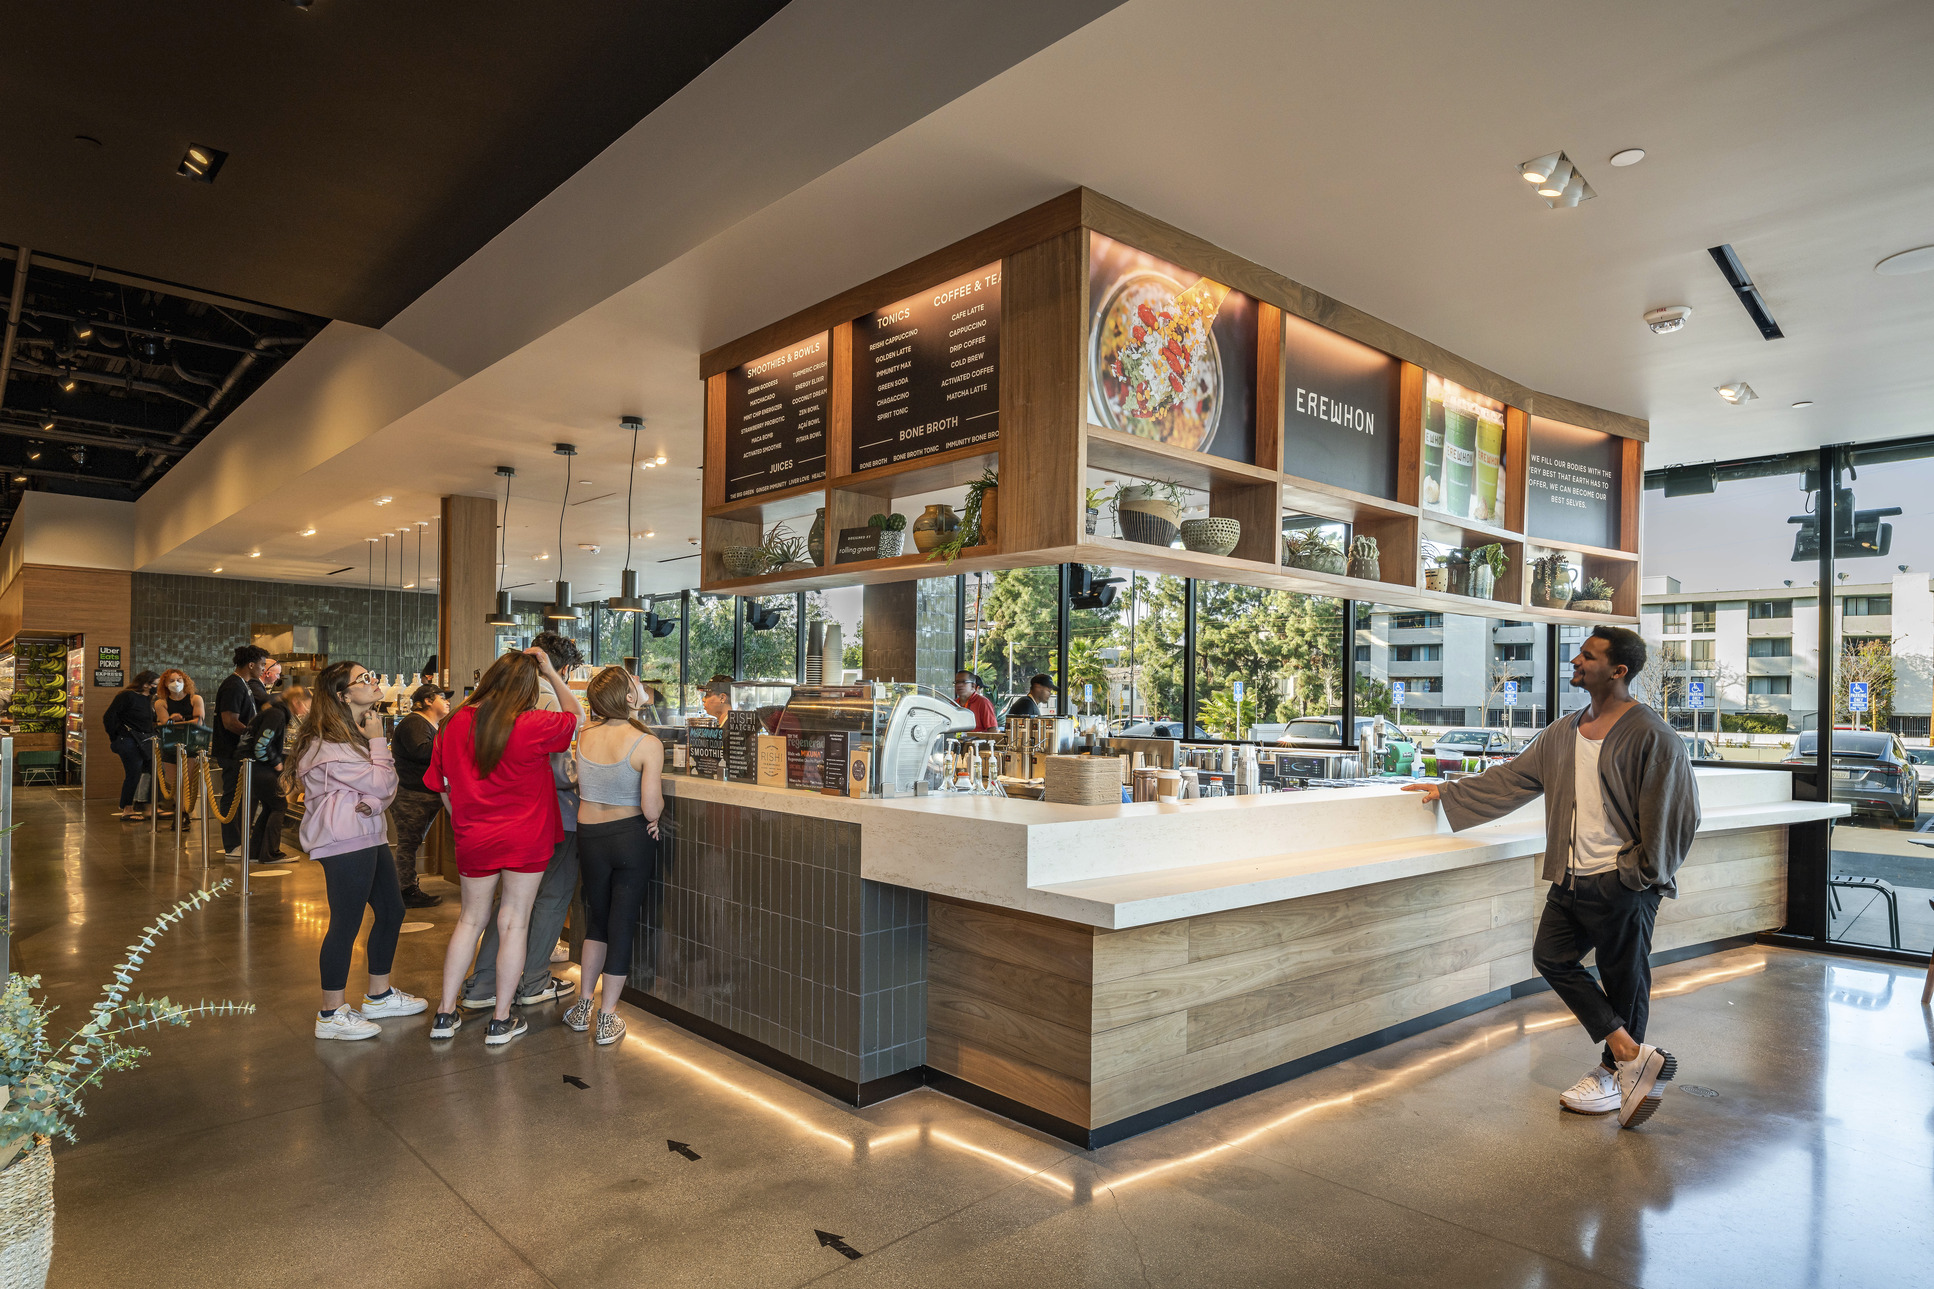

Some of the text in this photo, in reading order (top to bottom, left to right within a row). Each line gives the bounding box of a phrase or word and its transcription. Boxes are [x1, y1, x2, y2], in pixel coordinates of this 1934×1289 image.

[933, 272, 1002, 307] COFFEE & TEA
[877, 308, 910, 329] TONICS
[951, 303, 985, 321] CAFE LATTE
[949, 319, 987, 338] CAPPUCCINO
[869, 328, 919, 351] REISHI CAPPUCCINO
[949, 335, 986, 354] DRIP COFFEE
[747, 342, 820, 379] SMOOTHIES & BOWLS
[875, 345, 912, 364] GOLDEN LATTE
[950, 351, 985, 369] COLD BREW
[792, 360, 828, 378] TURMERIC CRUSH
[876, 360, 912, 378] IMMUNITY MAX
[941, 365, 994, 388] ACTIVATED COFFEE
[747, 379, 779, 395] GREEN GODDESS
[795, 375, 825, 391] ENERGY ELIXIR
[877, 376, 909, 392] GREEN SODA
[792, 387, 828, 405] COCONUT DREAM
[876, 391, 910, 407] CHAGACCINO
[946, 383, 988, 401] MATCHA LATTE
[743, 413, 752, 421] MINT
[752, 410, 761, 418] CHIP
[798, 404, 820, 417] ZEN BOWL
[877, 406, 909, 421] SPIRIT TONIC
[1296, 387, 1374, 435] EREWHON
[740, 415, 785, 435] STRAWBERRY PROBIOTIC
[808, 417, 820, 427] BOWL
[899, 415, 959, 441] BONE BROTH
[751, 431, 774, 444] MACA BOMB
[809, 430, 822, 440] BOWL
[945, 430, 999, 449] IMMUNITY BONE BRO
[743, 442, 782, 459] ACTIVATED SMOOTHIE
[893, 445, 940, 462] BONE BROTH TONIC
[769, 459, 794, 474] JUICES
[859, 457, 888, 470] BONE BROTH
[1531, 454, 1612, 479] WE FILL OUR BODIES WITH THE
[755, 481, 787, 494] GINGER IMMUNITY
[788, 474, 810, 486] LIVER LOVE
[1542, 469, 1556, 479] BEST
[1557, 472, 1571, 481] THAT
[1572, 475, 1589, 486] EARTH
[1590, 479, 1601, 488] HAS
[1602, 481, 1609, 490] TO
[743, 488, 755, 497] GREEN
[1528, 478, 1607, 501] OFFER, WE CAN BECOME OUR
[1550, 495, 1587, 509] BEST SELVES.
[839, 546, 876, 555] rolling greens
[99, 660, 120, 668] PICKUP
[729, 712, 756, 725] RISHI
[729, 723, 756, 732] MATCHA
[690, 747, 724, 759] SMOOTHIE
[760, 751, 783, 763] RISHI
